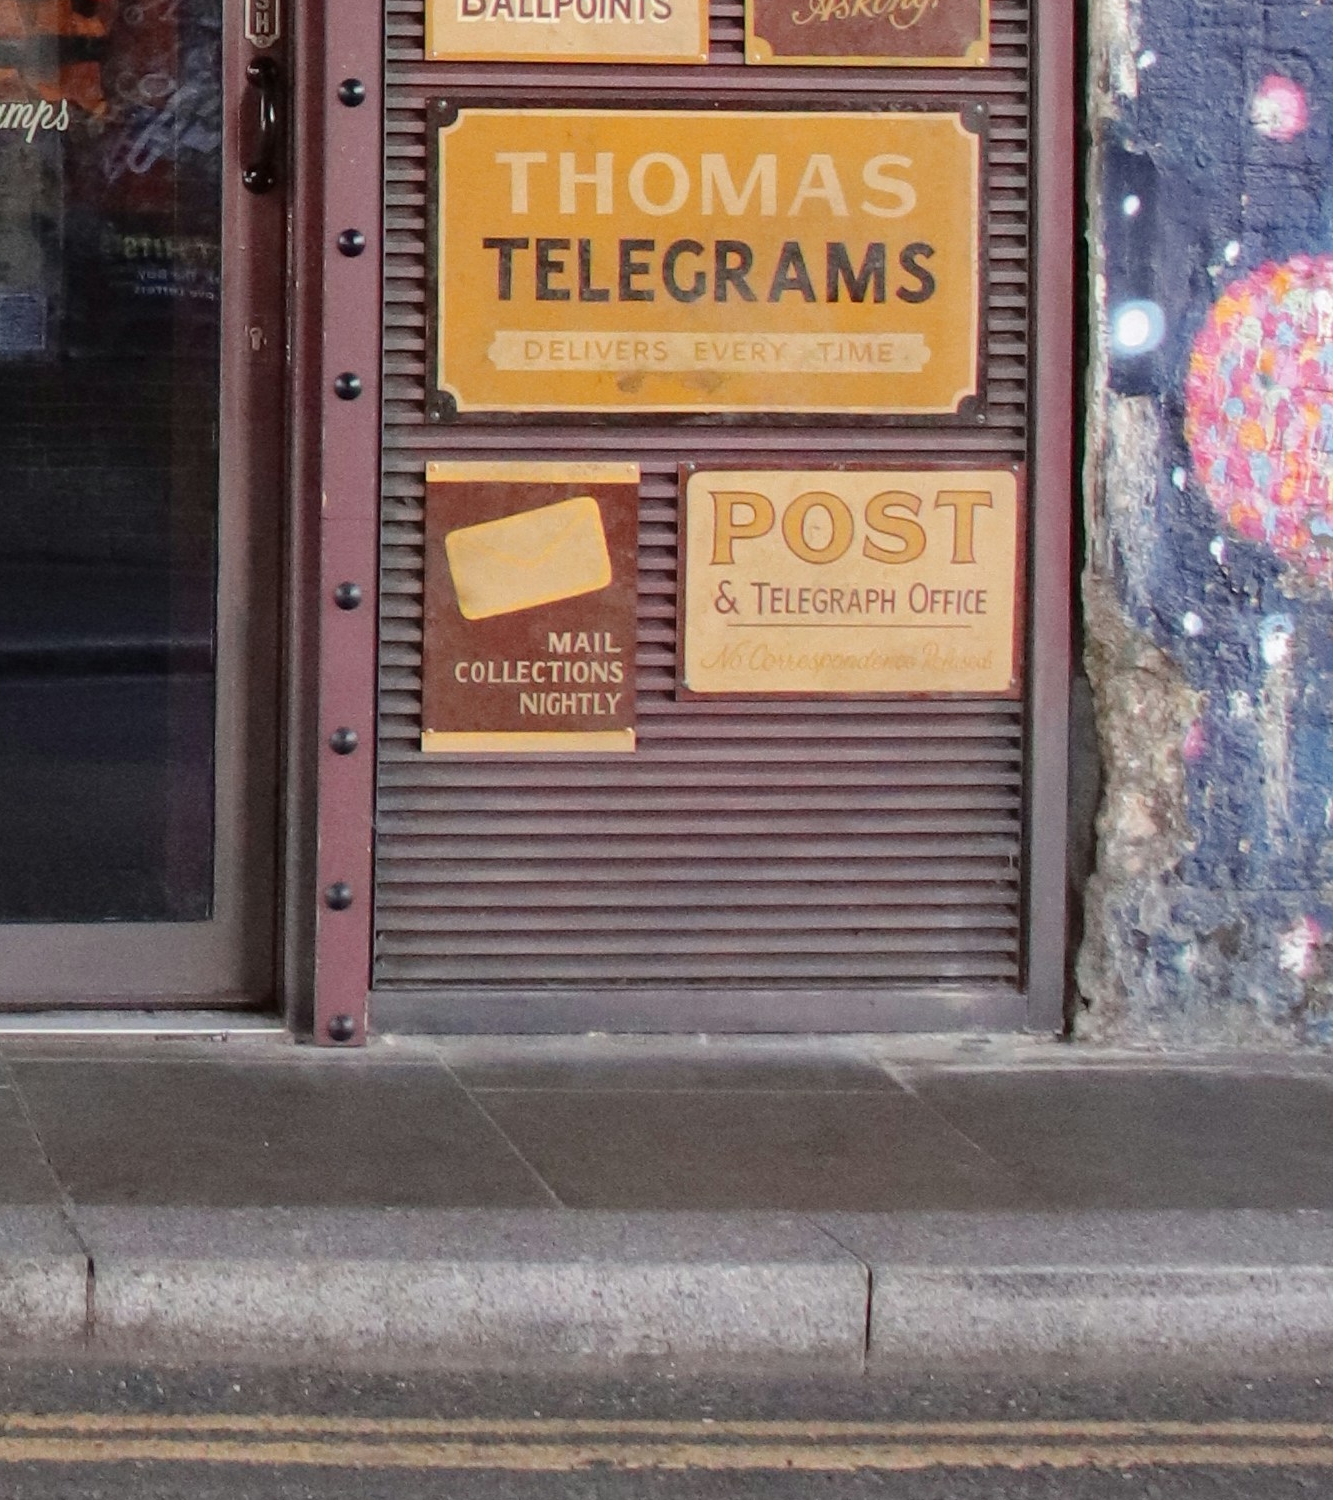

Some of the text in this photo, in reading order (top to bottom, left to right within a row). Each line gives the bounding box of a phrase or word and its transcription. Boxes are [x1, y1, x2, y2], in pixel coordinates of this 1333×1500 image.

[495, 152, 917, 218] THOMAS
[483, 237, 936, 304] TELEGRAMS
[524, 339, 668, 362] DELIVERS
[694, 341, 786, 363] EVERY
[709, 490, 993, 566] POST
[714, 580, 987, 615] & TELEGRAPH OFFICE
[548, 632, 621, 654] MAIL
[455, 661, 624, 684] COLLECTIONS
[520, 693, 621, 716] NIGHTLY
